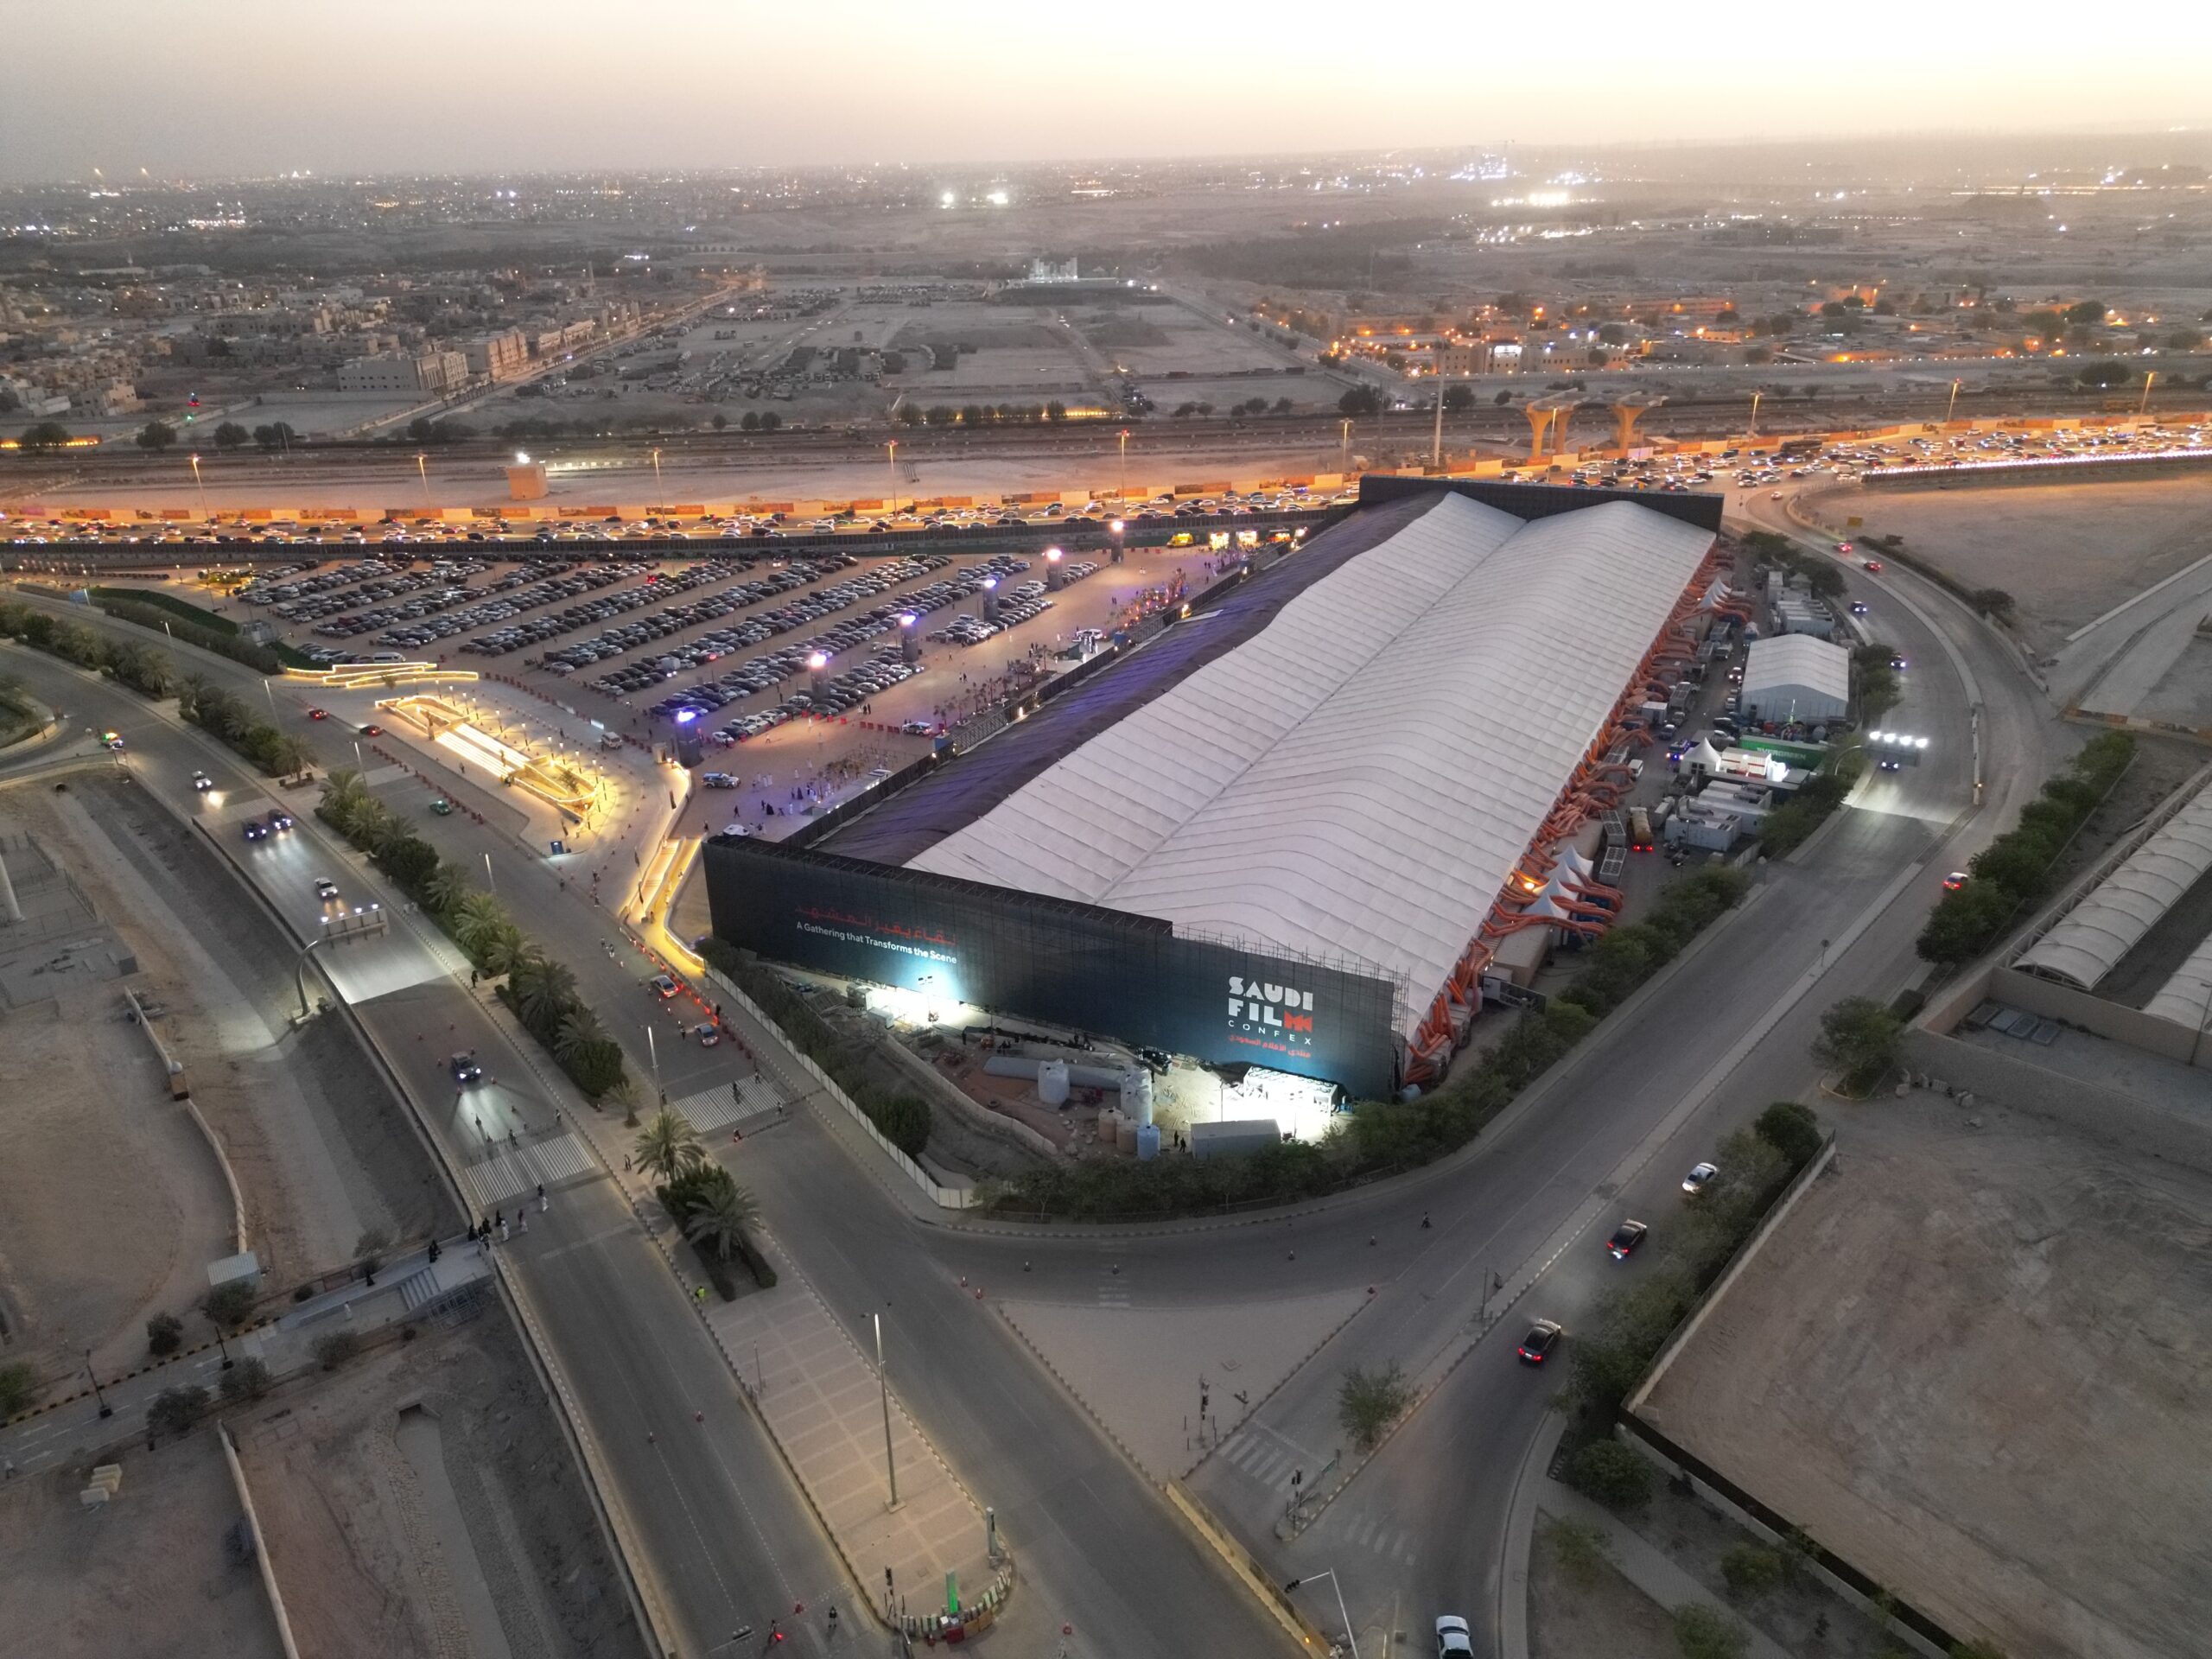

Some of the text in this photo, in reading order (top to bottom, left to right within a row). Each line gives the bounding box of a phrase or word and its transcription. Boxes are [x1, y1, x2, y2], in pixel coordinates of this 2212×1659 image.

[796, 921, 957, 964] A Gathering that Transforms the Scene
[1229, 976, 1313, 1011] SAUDI
[1229, 997, 1313, 1033] FILM
[1228, 1020, 1312, 1046] CONFEX
